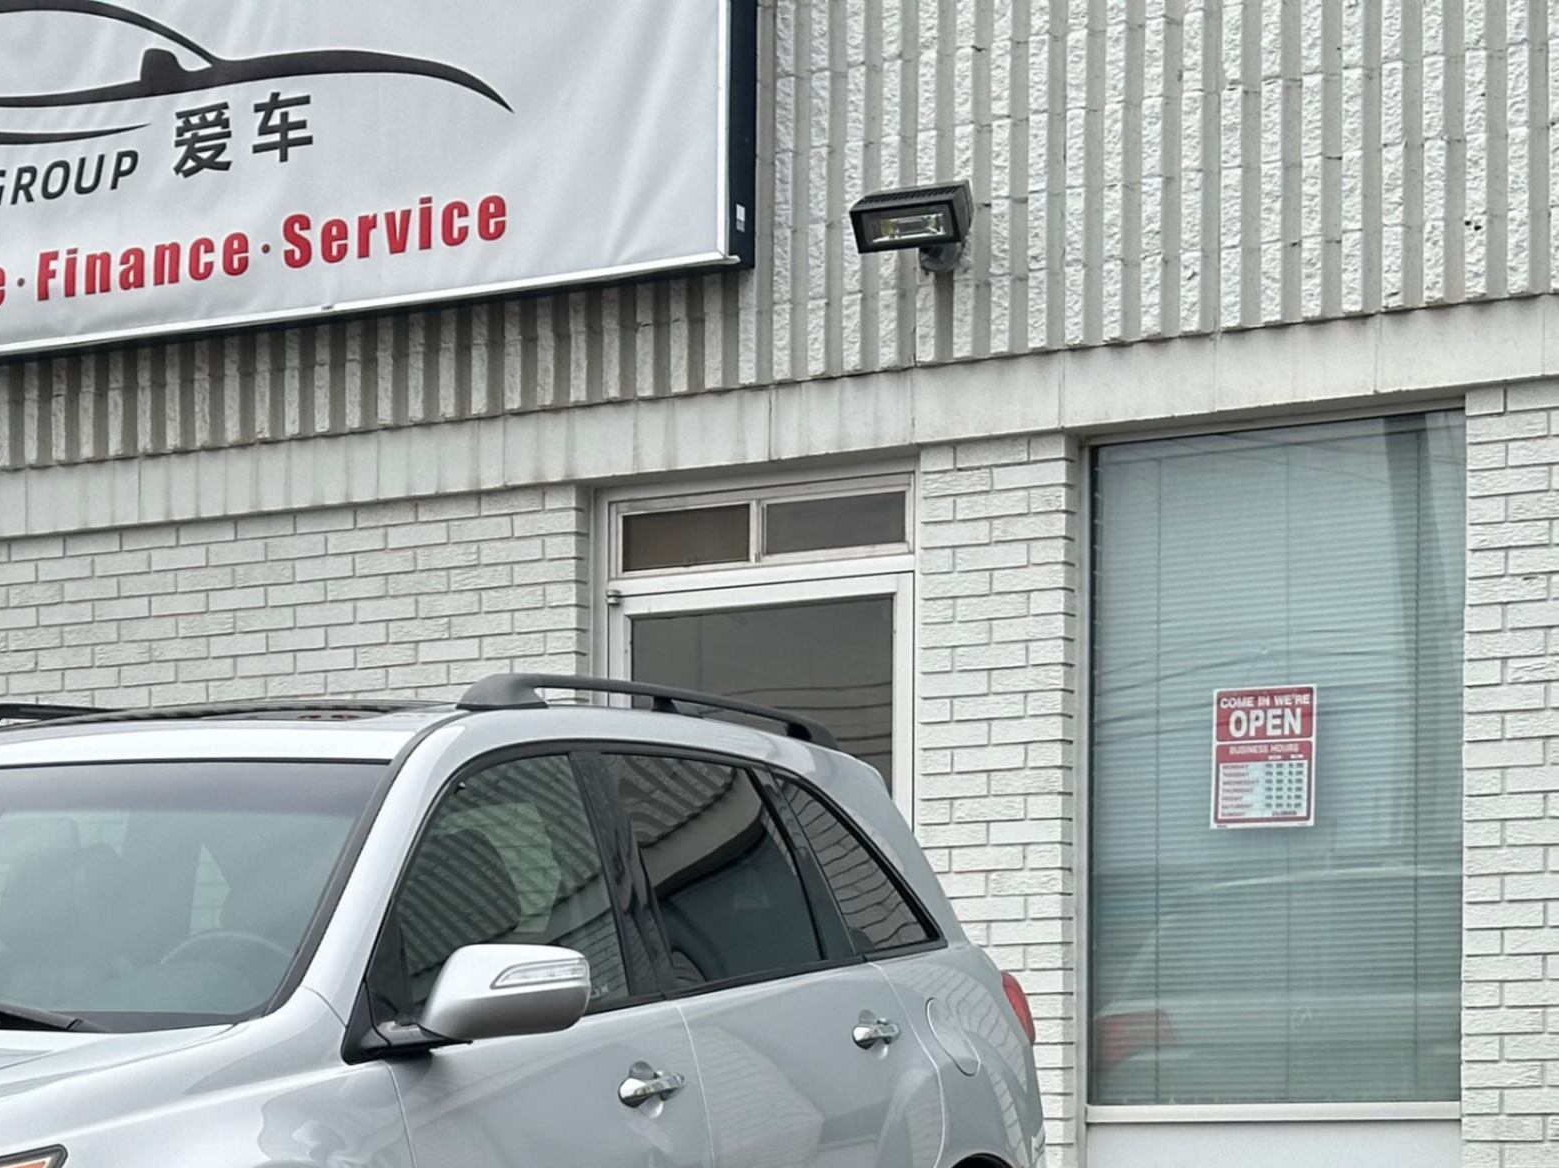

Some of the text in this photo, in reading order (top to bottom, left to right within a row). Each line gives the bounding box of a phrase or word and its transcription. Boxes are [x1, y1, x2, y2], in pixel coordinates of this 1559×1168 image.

[172, 91, 314, 178] 爱车
[36, 231, 250, 302] Finance
[282, 193, 508, 269] Service
[1220, 693, 1311, 709] COME IN WE'RE
[1228, 707, 1302, 738] OPEN
[1229, 743, 1299, 755] BUSINESS HOURS
